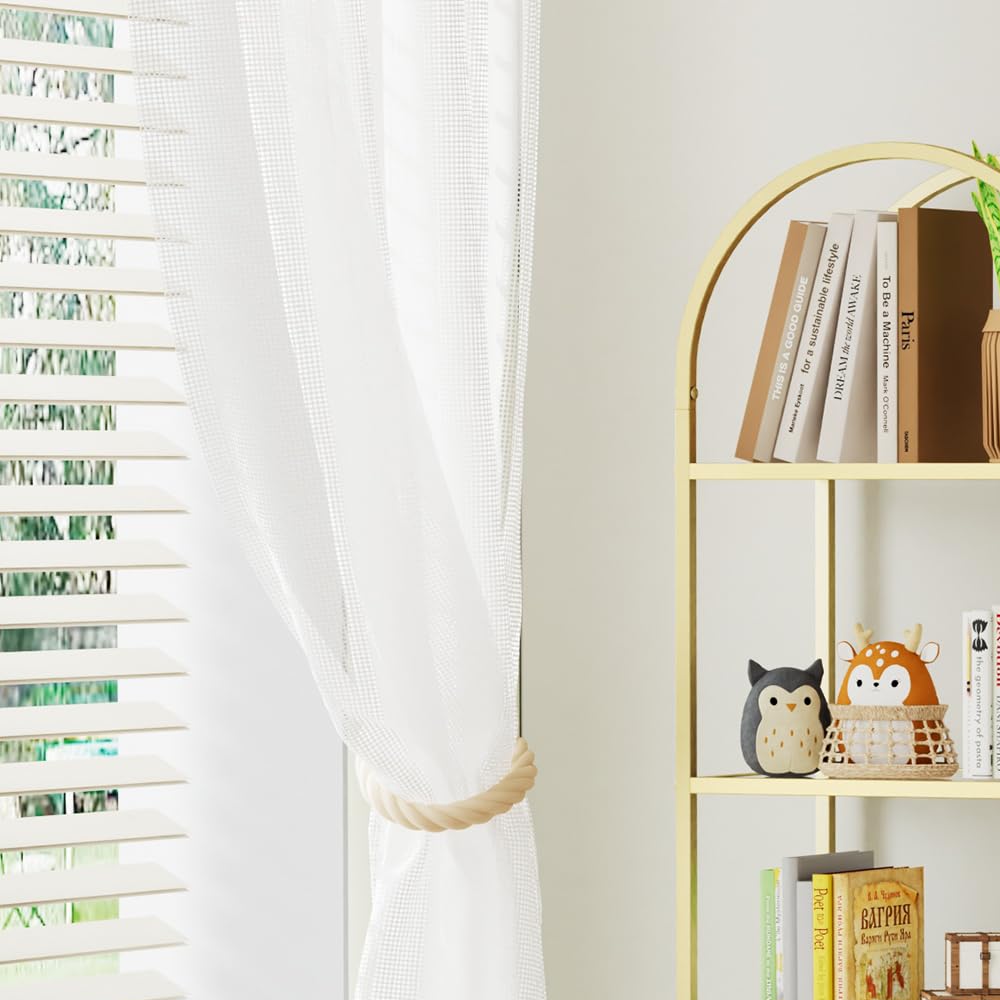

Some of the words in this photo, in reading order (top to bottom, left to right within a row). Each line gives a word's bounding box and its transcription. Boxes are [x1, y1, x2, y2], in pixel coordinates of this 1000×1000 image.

[821, 243, 840, 285] lifestyle
[793, 275, 809, 313] GUIDE
[881, 275, 892, 289] To
[848, 274, 862, 317] AWAKE
[881, 292, 892, 308] Be
[808, 286, 829, 348] sustainable
[845, 317, 855, 341] world
[784, 314, 800, 350] GOOD
[901, 312, 915, 351] Paris
[783, 351, 791, 361] A
[807, 349, 815, 357] a
[841, 342, 851, 355] the
[882, 321, 893, 369] Machine
[779, 362, 789, 375] IS
[801, 358, 812, 374] for
[772, 375, 785, 400] THIS
[833, 356, 848, 401] DREAM
[976, 656, 984, 673] the
[975, 675, 984, 724] geometry
[976, 727, 984, 738] of
[814, 888, 828, 911] Poet
[861, 904, 911, 930] ВАГРИЯ
[814, 928, 829, 951] Poet
